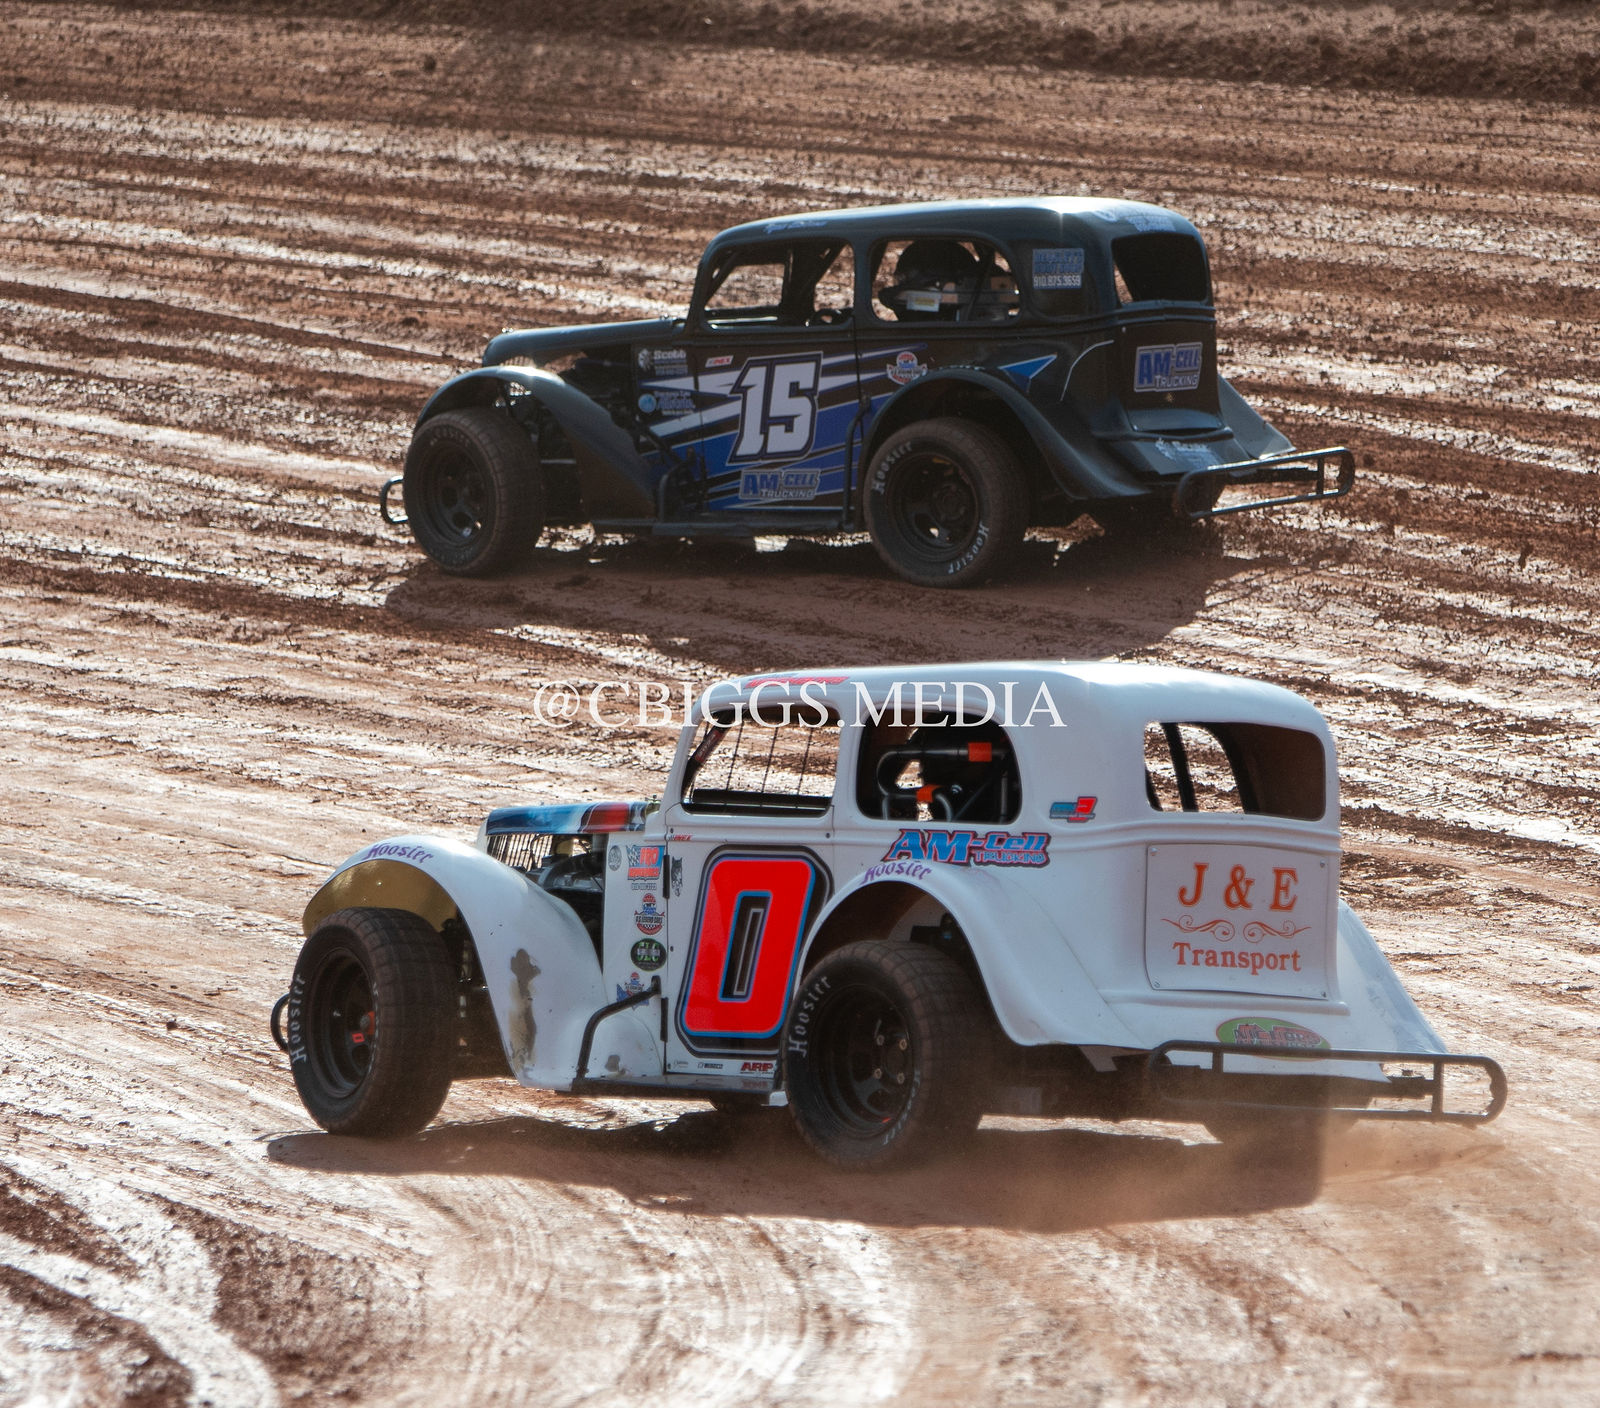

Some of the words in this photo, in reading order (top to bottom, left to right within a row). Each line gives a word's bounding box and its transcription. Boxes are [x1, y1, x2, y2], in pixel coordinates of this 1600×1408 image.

[1155, 374, 1199, 388] TRUCKING
[731, 355, 821, 461] 15
[760, 487, 816, 499] TRUCKING
[361, 842, 434, 864] Hoosier
[974, 851, 1046, 865] TRUCKING
[860, 861, 933, 886] Hoosier
[1177, 862, 1209, 907] J
[1222, 864, 1255, 910] &
[1268, 867, 1298, 912] E
[682, 857, 816, 1039] 0
[1172, 941, 1302, 976] Transport
[788, 976, 832, 1058] Hoosier
[741, 1061, 774, 1072] ARP
